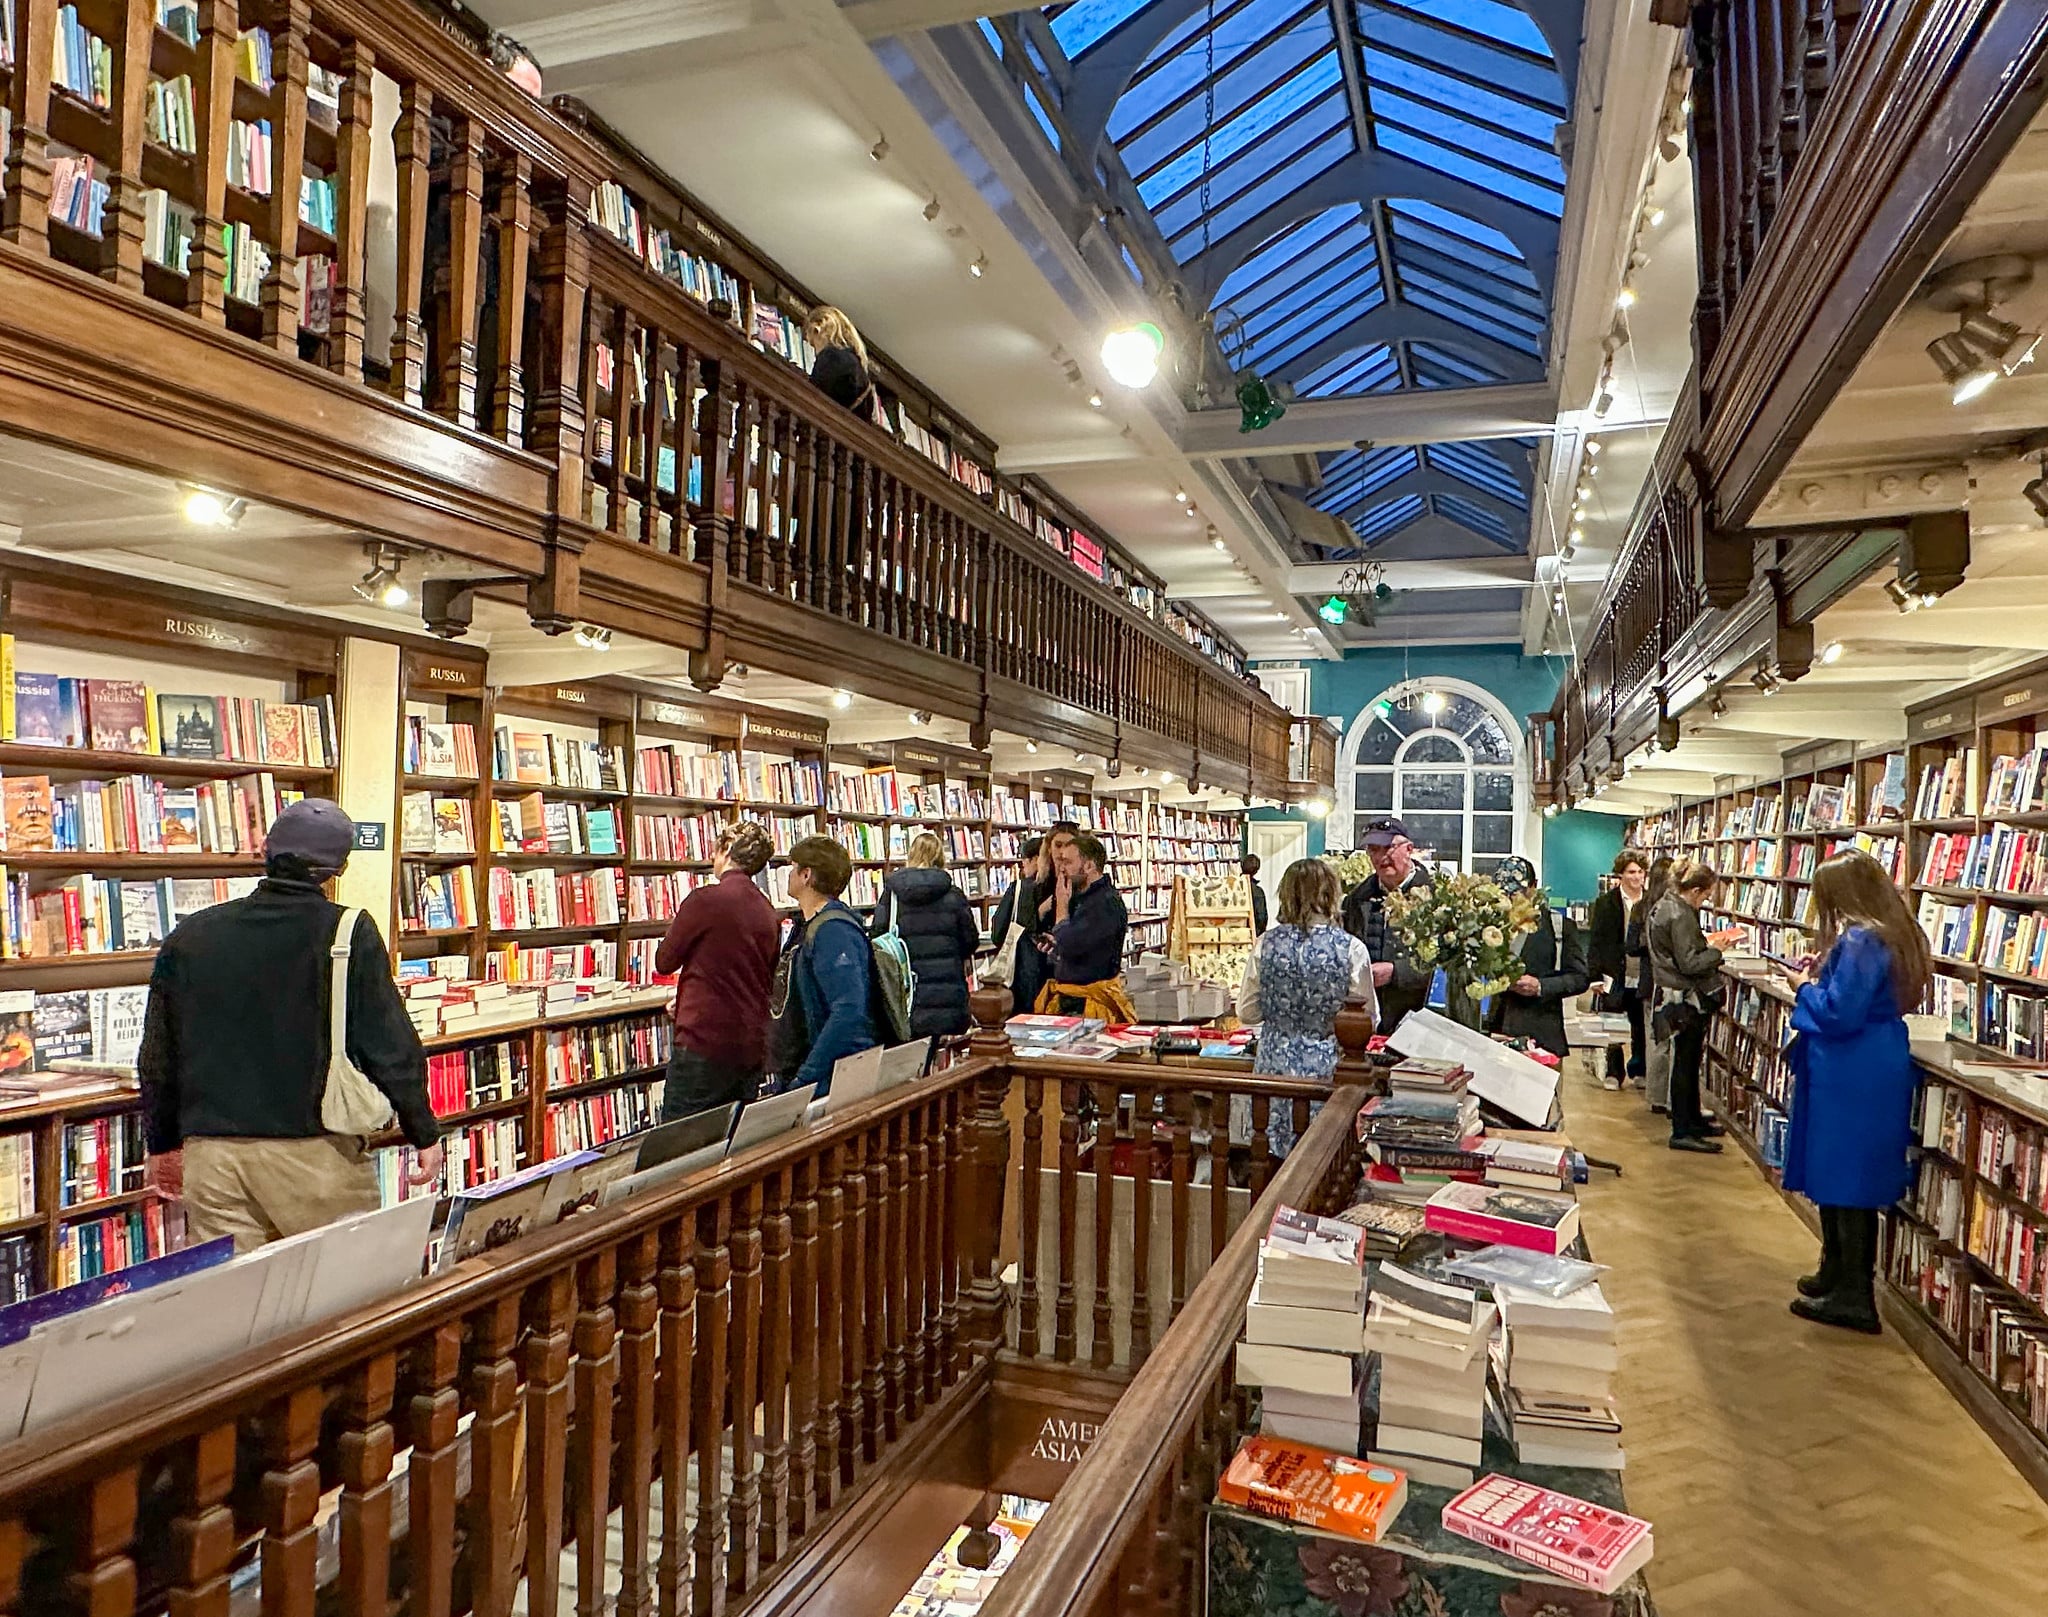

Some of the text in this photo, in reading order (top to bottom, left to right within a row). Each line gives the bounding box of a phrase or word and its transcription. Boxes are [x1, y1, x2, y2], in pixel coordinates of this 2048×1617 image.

[166, 618, 221, 641] RUSSIA
[430, 667, 466, 683] RUSSIA
[14, 684, 51, 696] ussia
[556, 688, 586, 703] RUSSIA
[4, 791, 43, 799] OSCOW
[1031, 1438, 1082, 1462] ASIA
